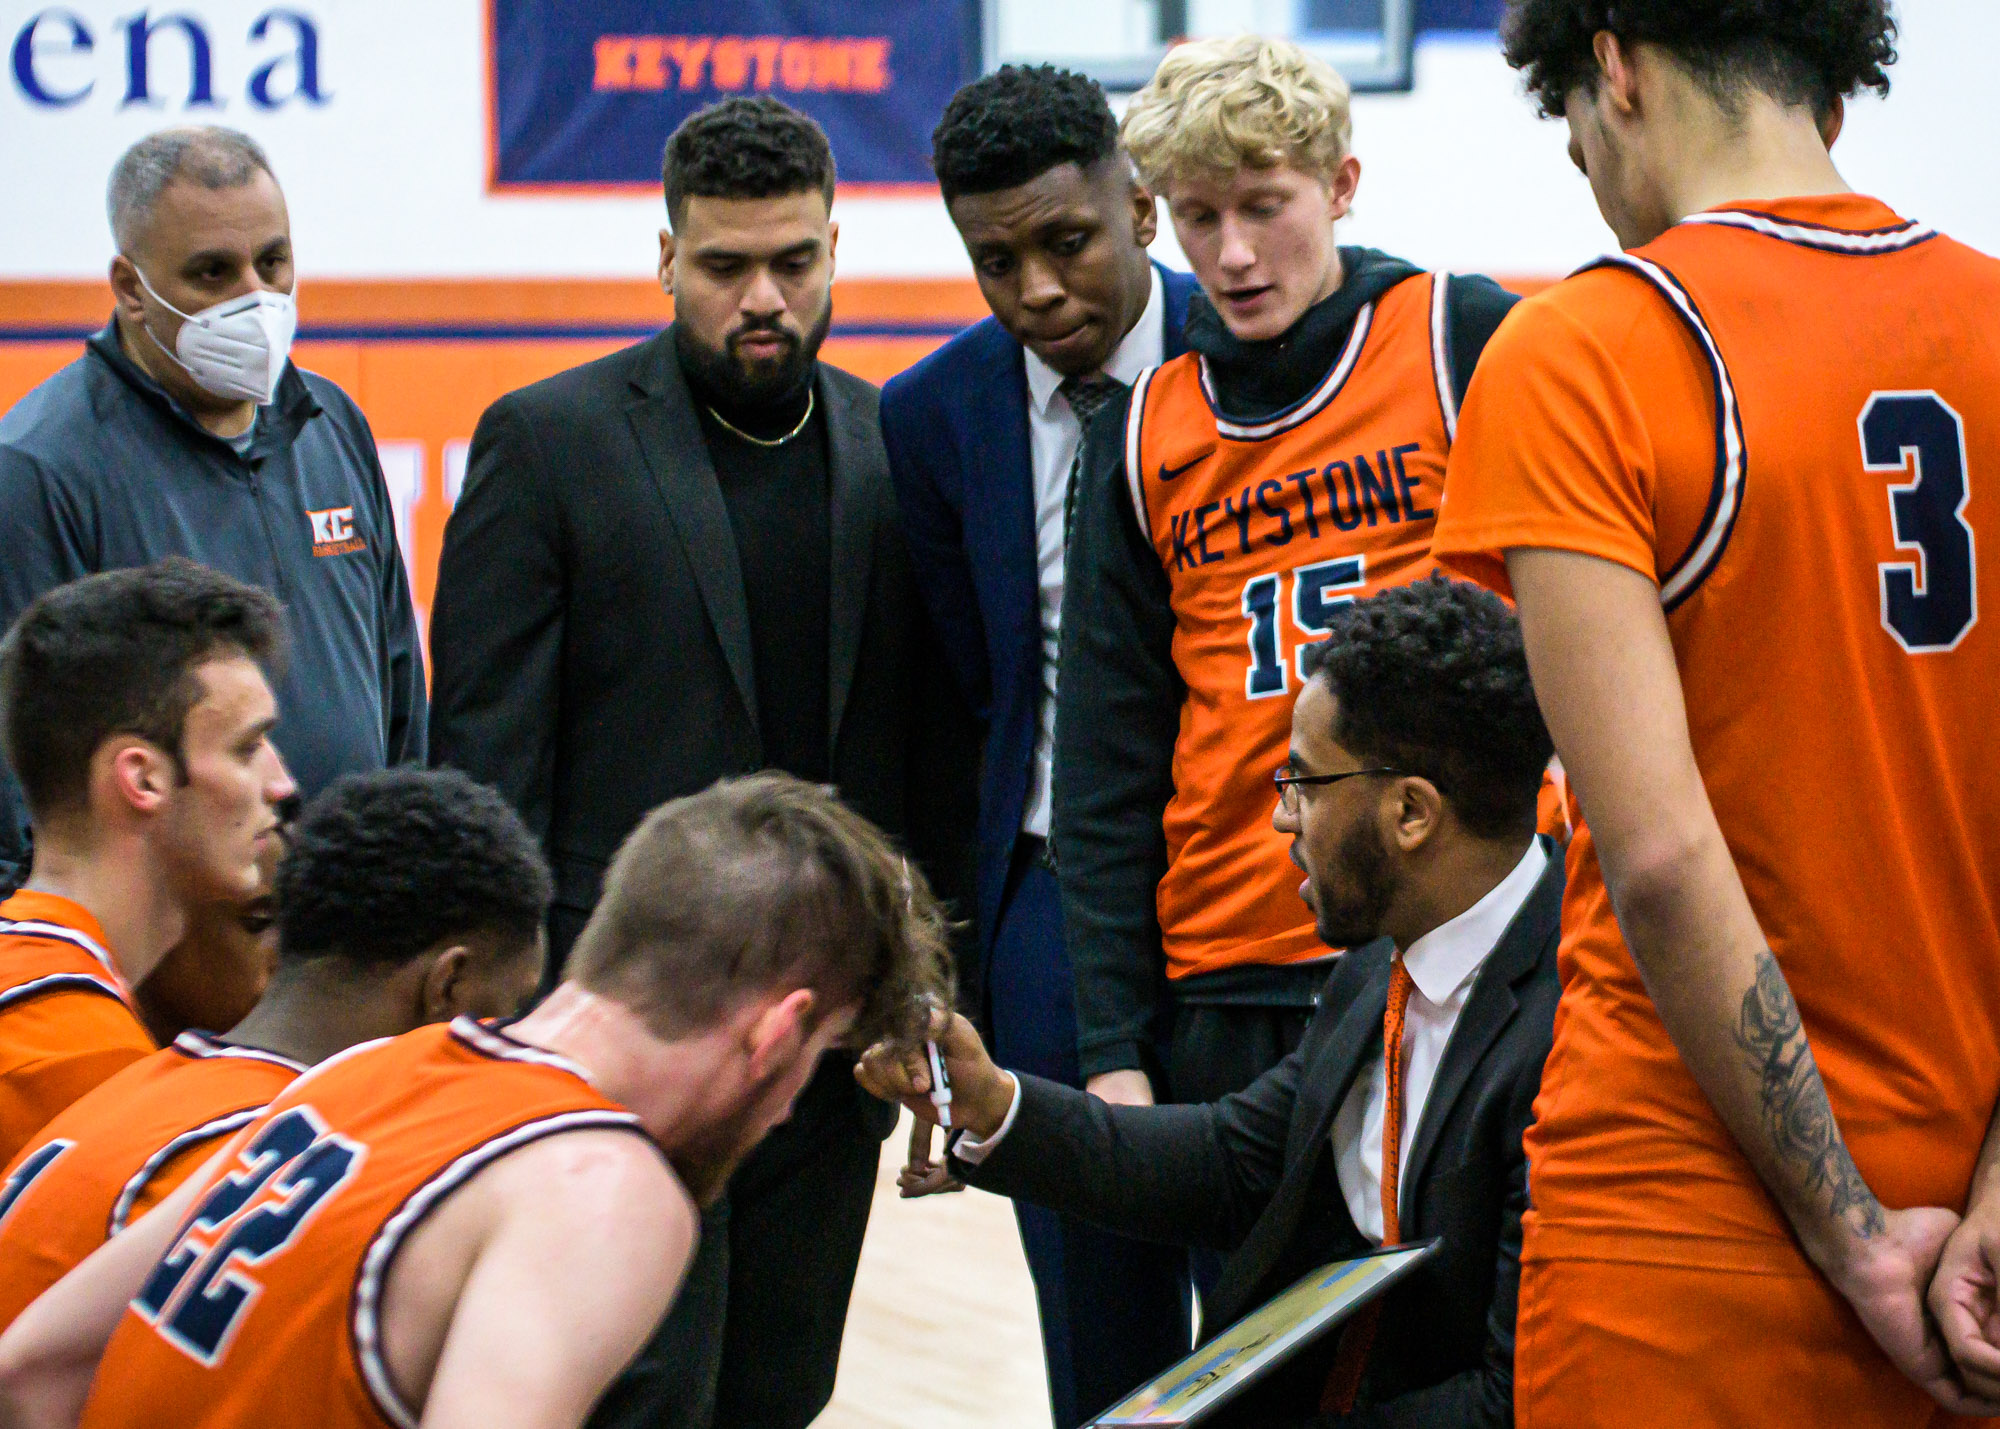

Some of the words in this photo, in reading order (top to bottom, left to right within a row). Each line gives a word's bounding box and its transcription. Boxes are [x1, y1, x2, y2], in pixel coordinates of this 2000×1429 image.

[9, 6, 333, 110] ena
[593, 36, 890, 92] KEYSTONE
[309, 506, 353, 543] KC
[1171, 442, 1434, 572] KEYSTONE
[1857, 389, 1978, 655] 3
[130, 1104, 368, 1367] 22
